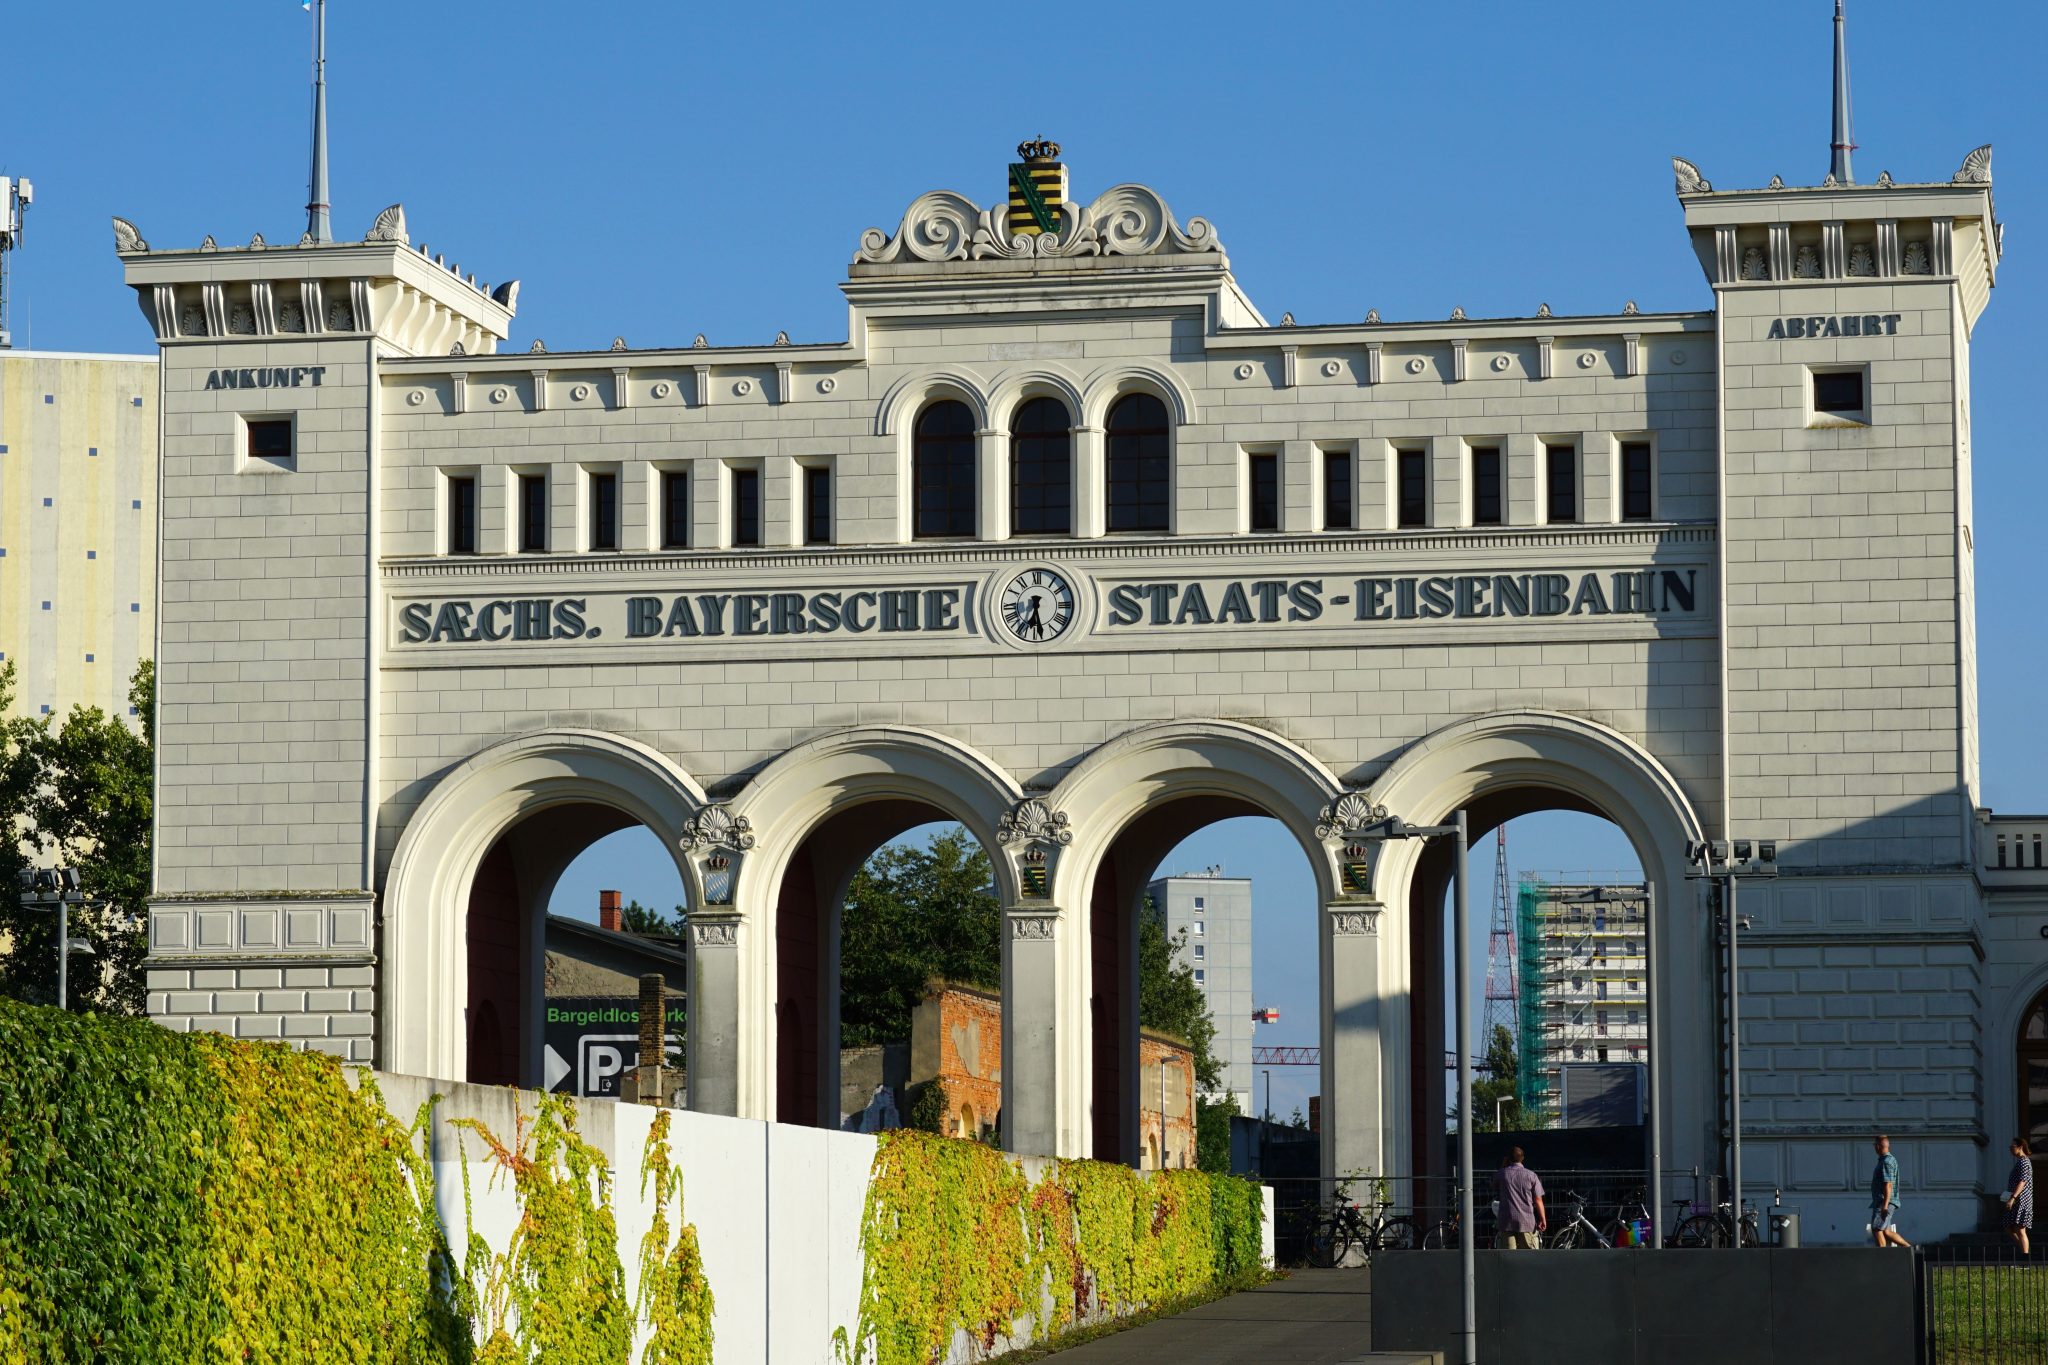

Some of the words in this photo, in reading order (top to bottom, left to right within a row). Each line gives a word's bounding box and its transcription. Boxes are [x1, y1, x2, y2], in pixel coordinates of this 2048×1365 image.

[1767, 314, 1901, 339] ABFAHRT
[205, 367, 326, 391] ANKUNFT
[625, 589, 959, 638] BAYERSCHE
[547, 1007, 639, 1026] Bargeldlos
